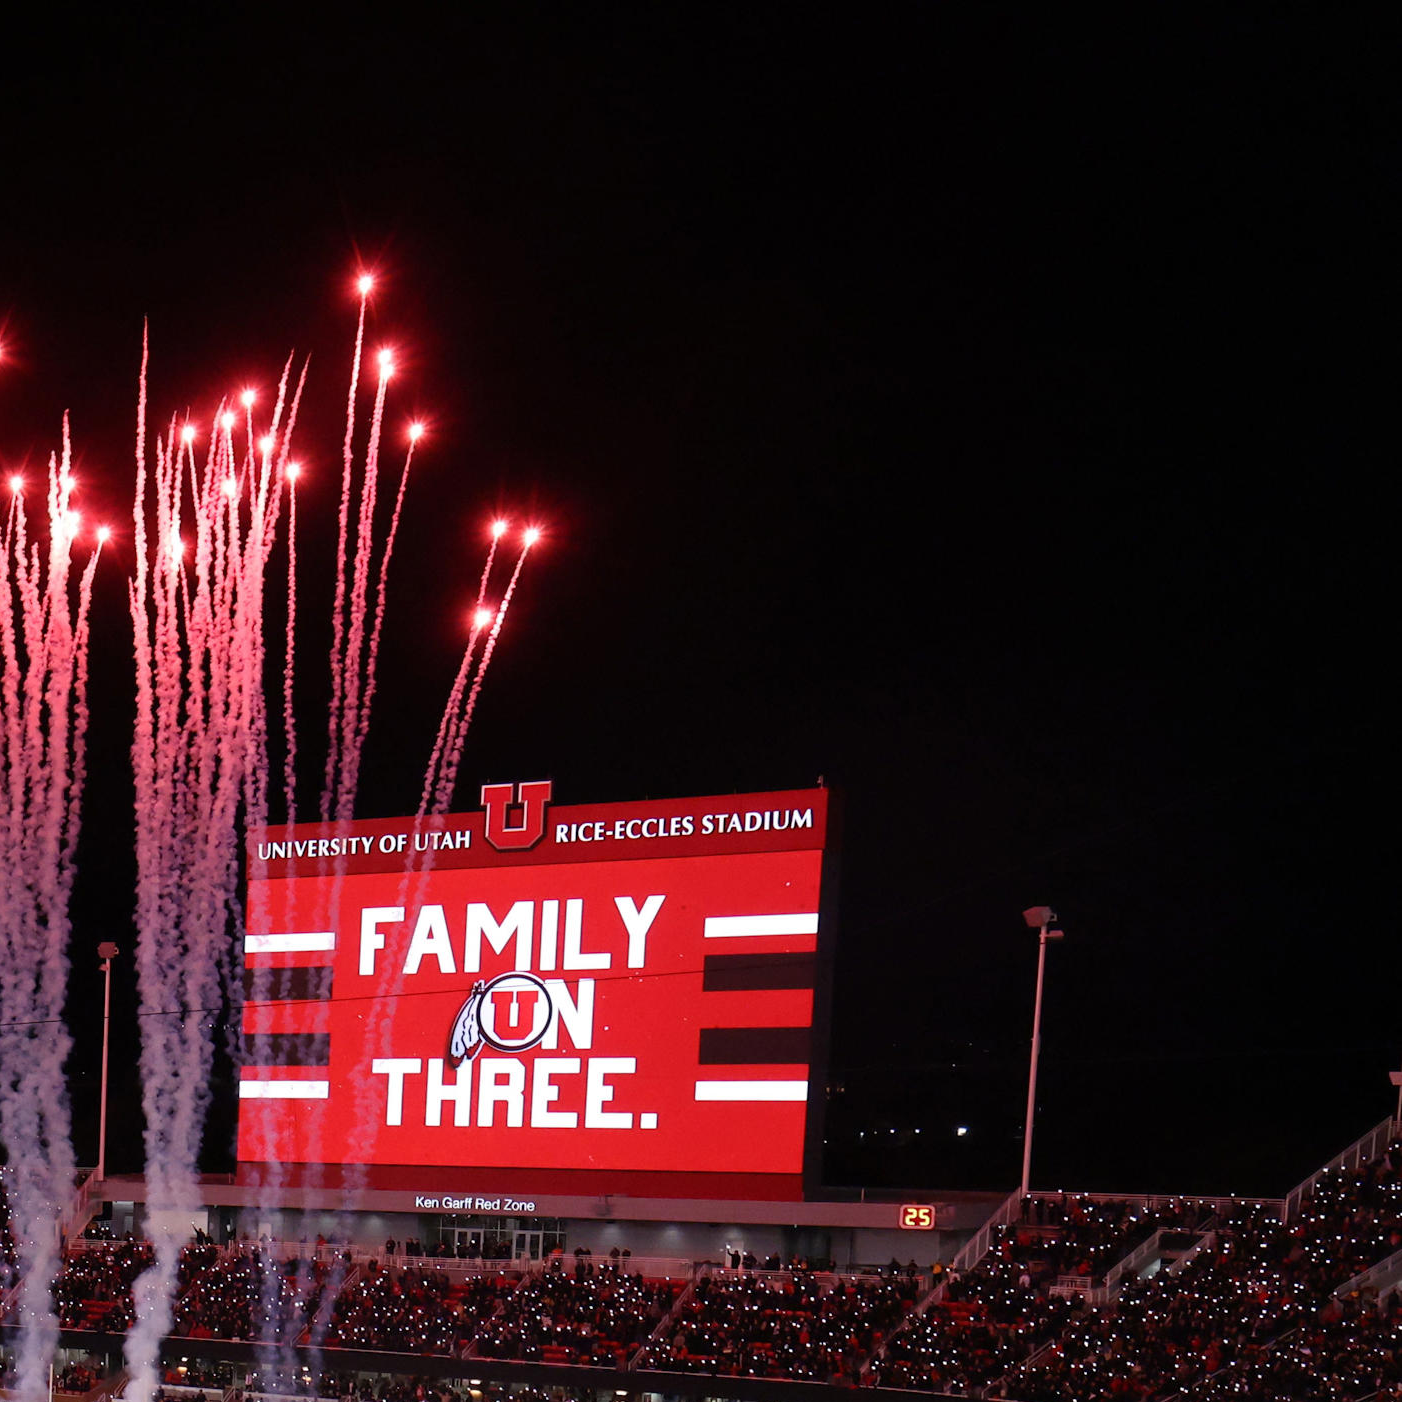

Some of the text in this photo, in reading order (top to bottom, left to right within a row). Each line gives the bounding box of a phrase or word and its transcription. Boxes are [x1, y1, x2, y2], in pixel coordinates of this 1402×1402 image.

[481, 781, 551, 852] U
[555, 808, 813, 844] RICE-ECCLES STADIUM
[258, 830, 471, 861] UNIVERSITY OF UTAH
[358, 894, 667, 976] FAMILY
[371, 1057, 658, 1129] THREE.
[415, 1196, 535, 1212] Ken Garff Red Zone
[902, 1205, 932, 1227] 25
